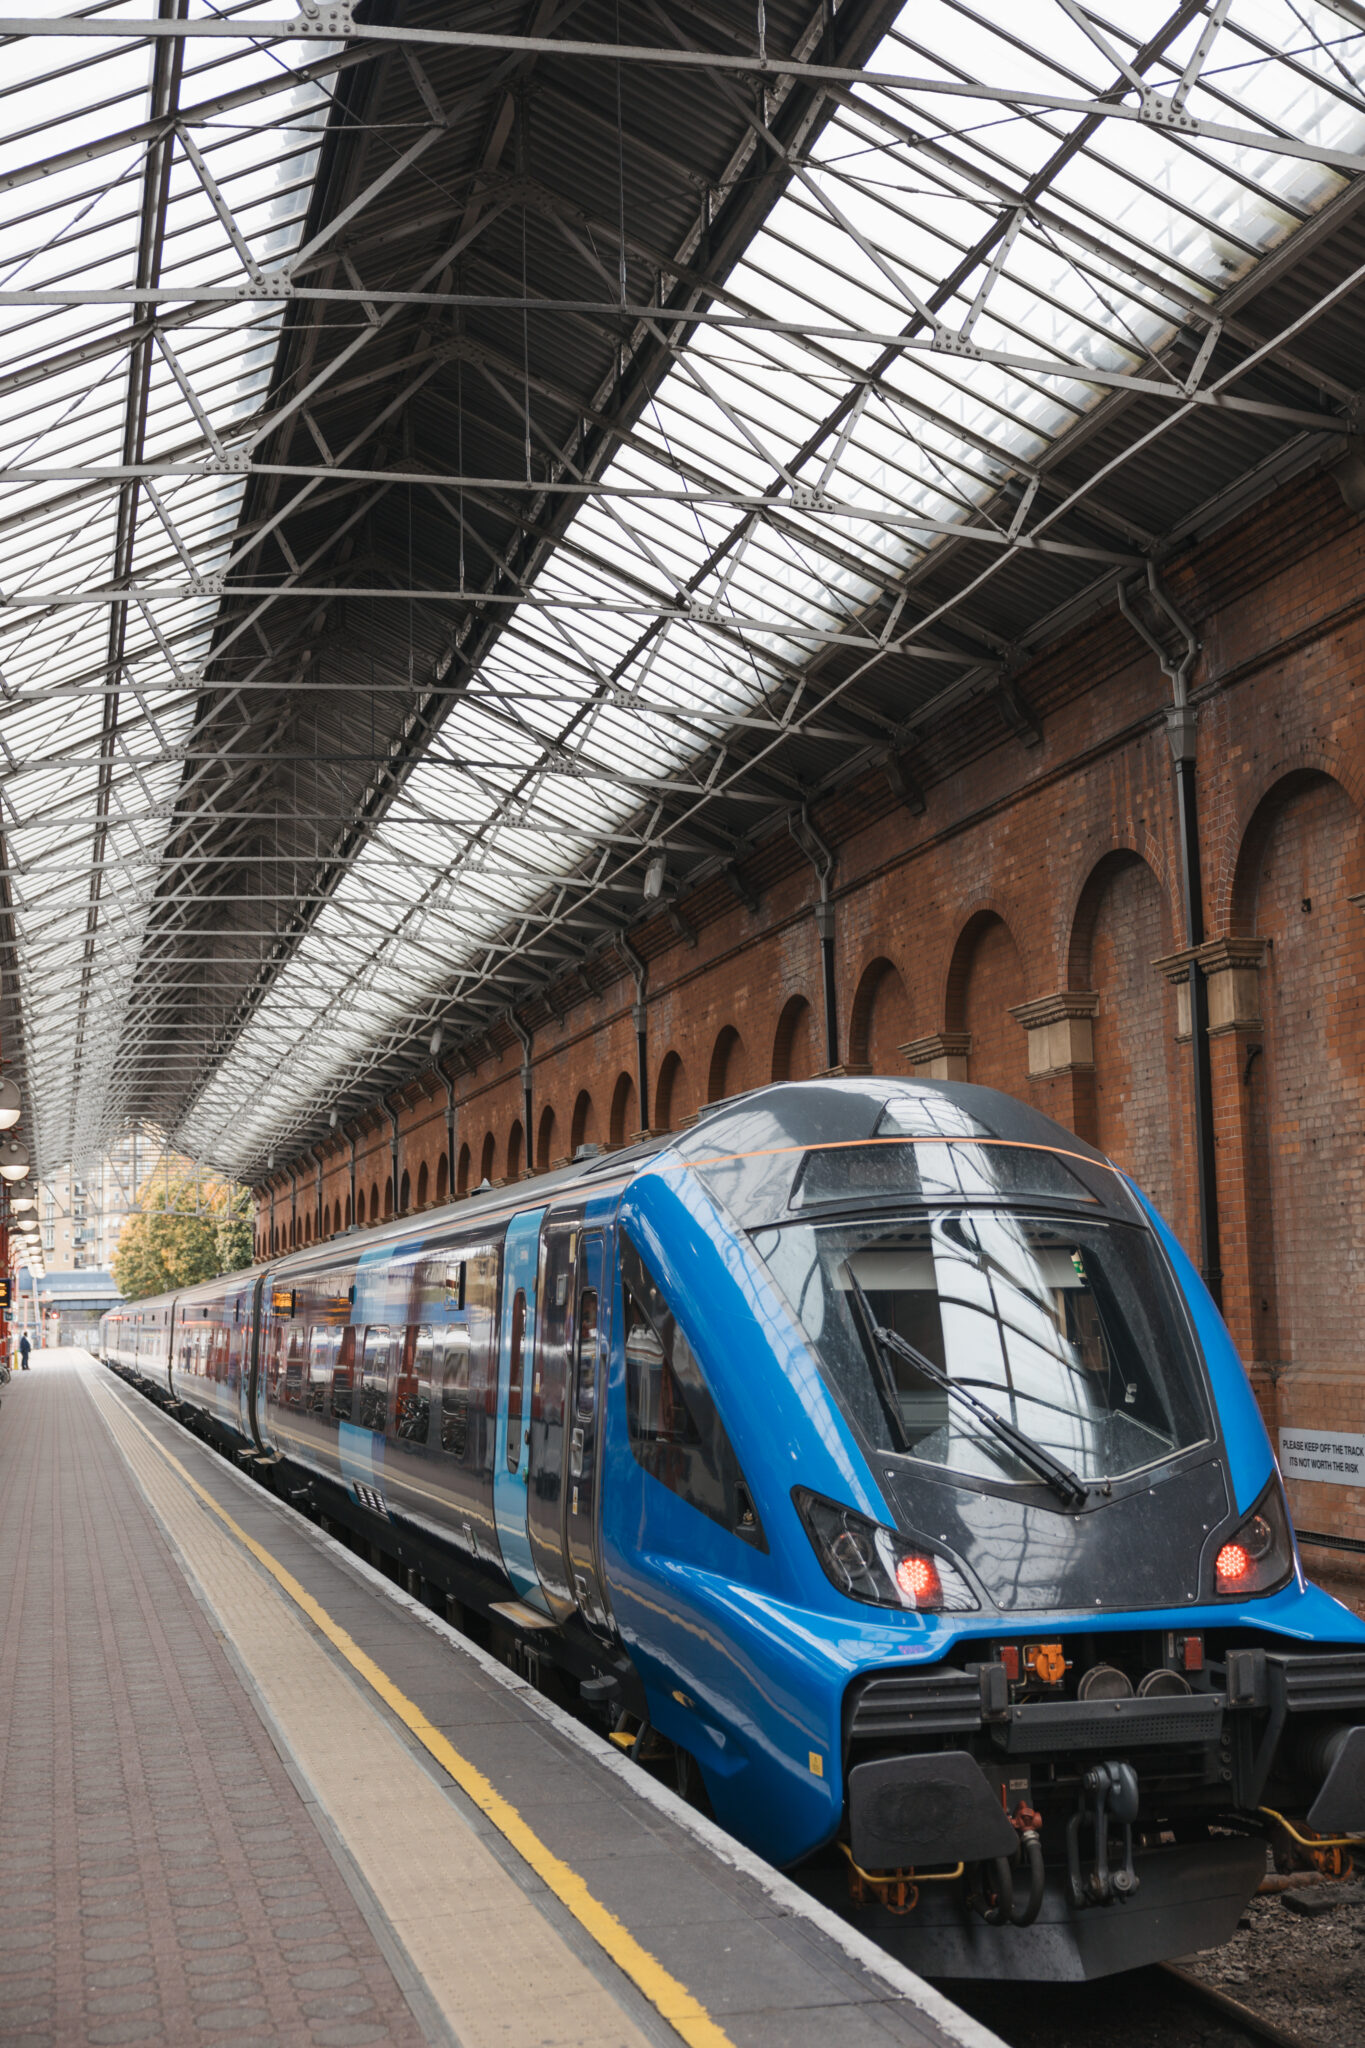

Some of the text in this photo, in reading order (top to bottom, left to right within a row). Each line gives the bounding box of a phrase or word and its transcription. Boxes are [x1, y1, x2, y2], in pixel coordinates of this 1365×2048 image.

[1283, 1440, 1364, 1457] PLEASE KEEP OFF THE TRACK
[1298, 1457, 1310, 1468] NOT
[1311, 1458, 1332, 1470] WORTH
[1332, 1461, 1344, 1472] THE
[1344, 1462, 1359, 1474] RISK
